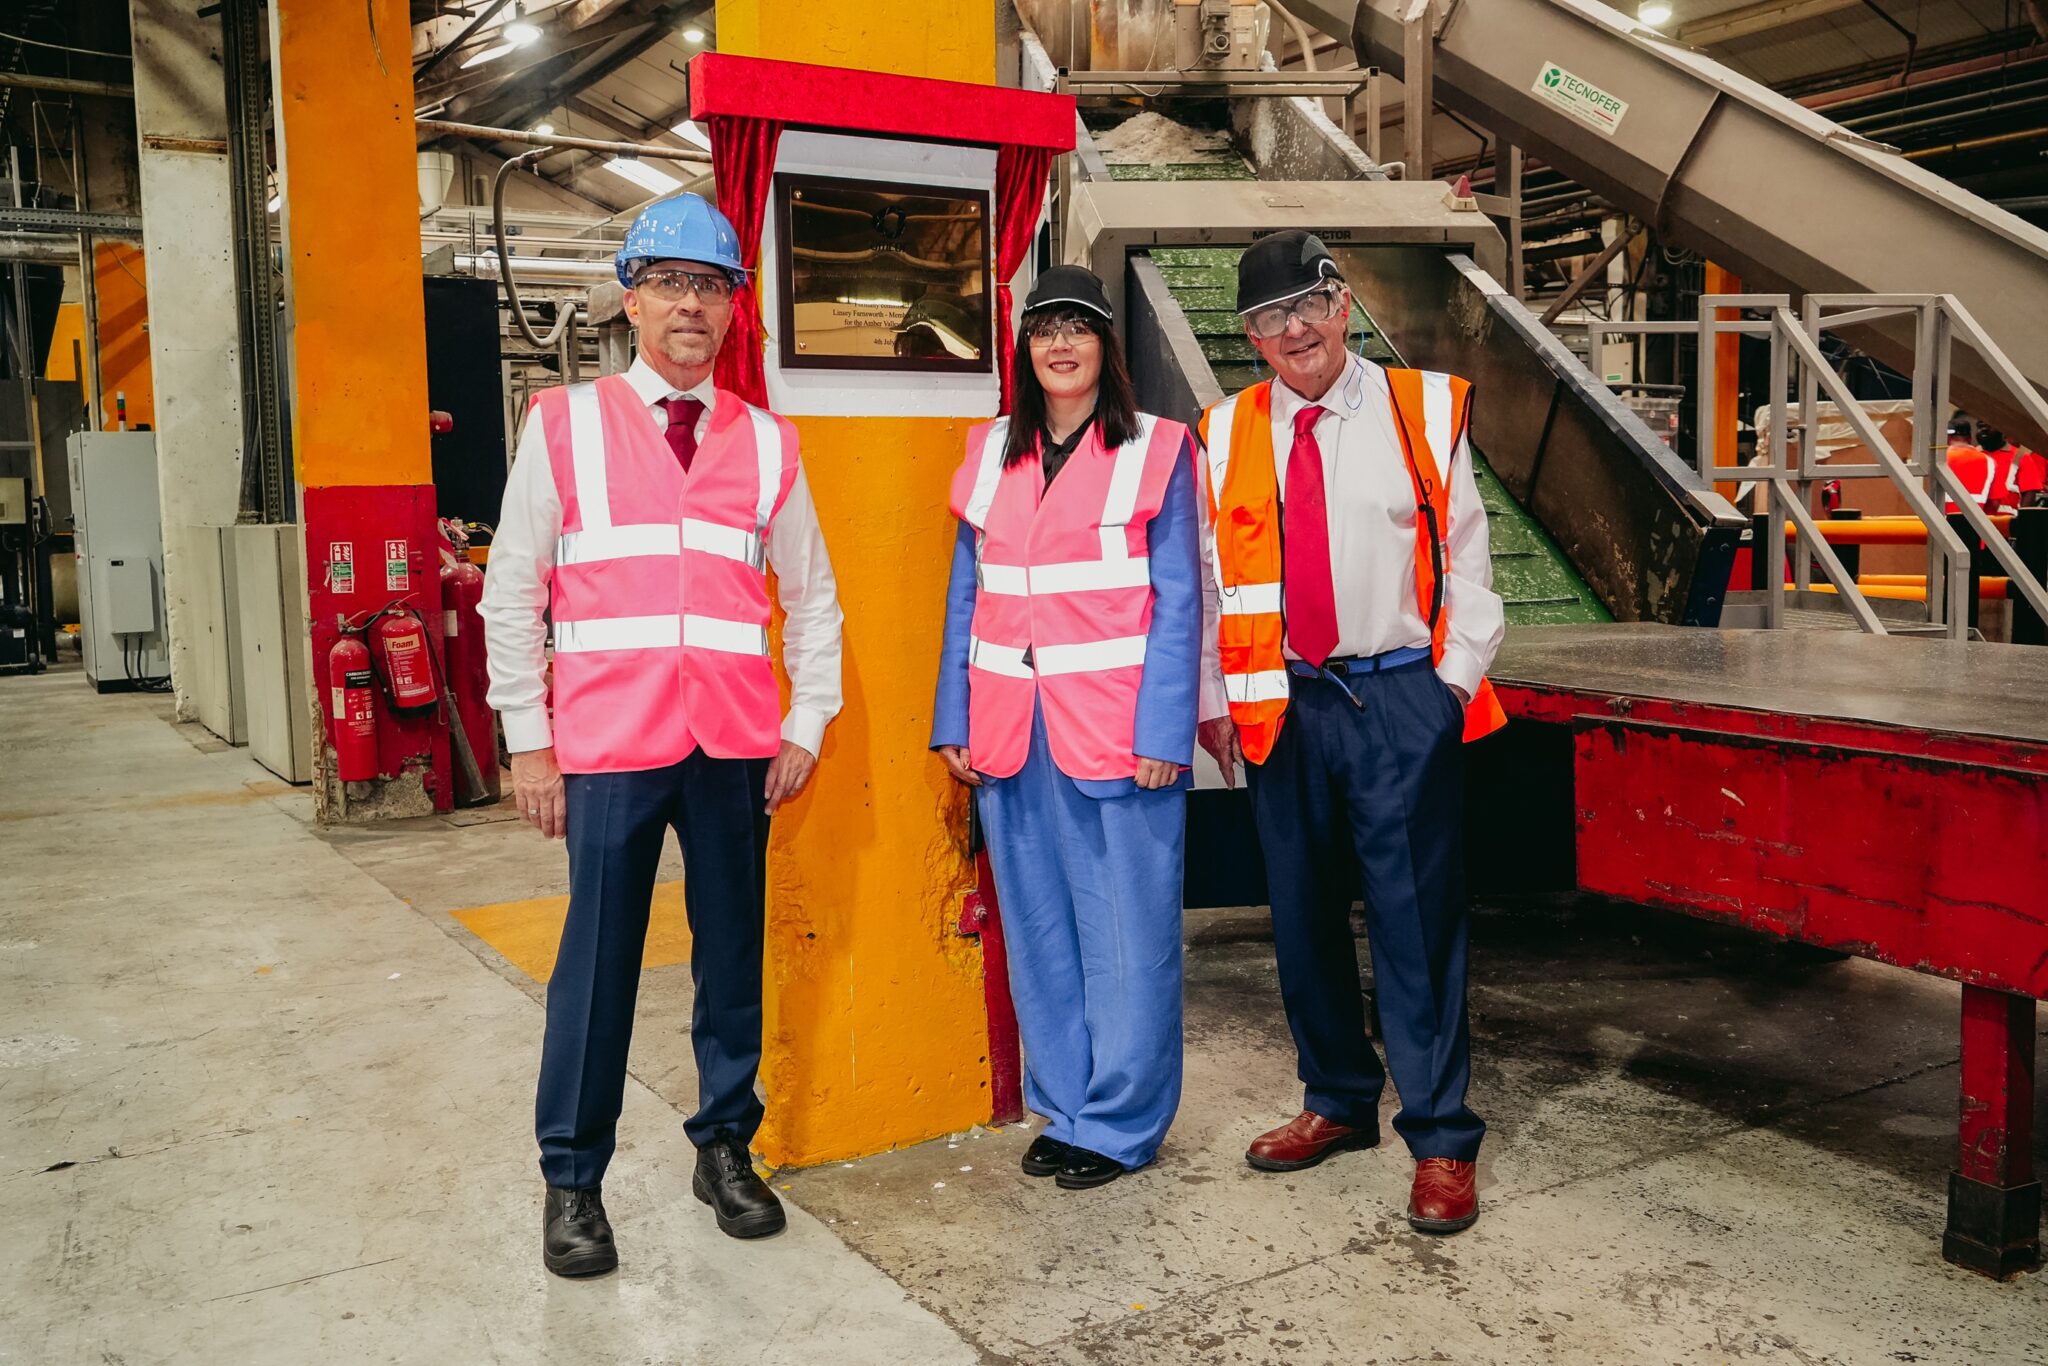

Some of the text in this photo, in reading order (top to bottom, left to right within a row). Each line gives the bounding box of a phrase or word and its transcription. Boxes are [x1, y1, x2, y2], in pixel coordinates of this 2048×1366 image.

[1561, 74, 1622, 114] TECNOFER
[832, 309, 852, 318] Linsey
[853, 310, 884, 318] Farnsworth
[854, 319, 862, 327] the
[392, 640, 413, 649] Foam
